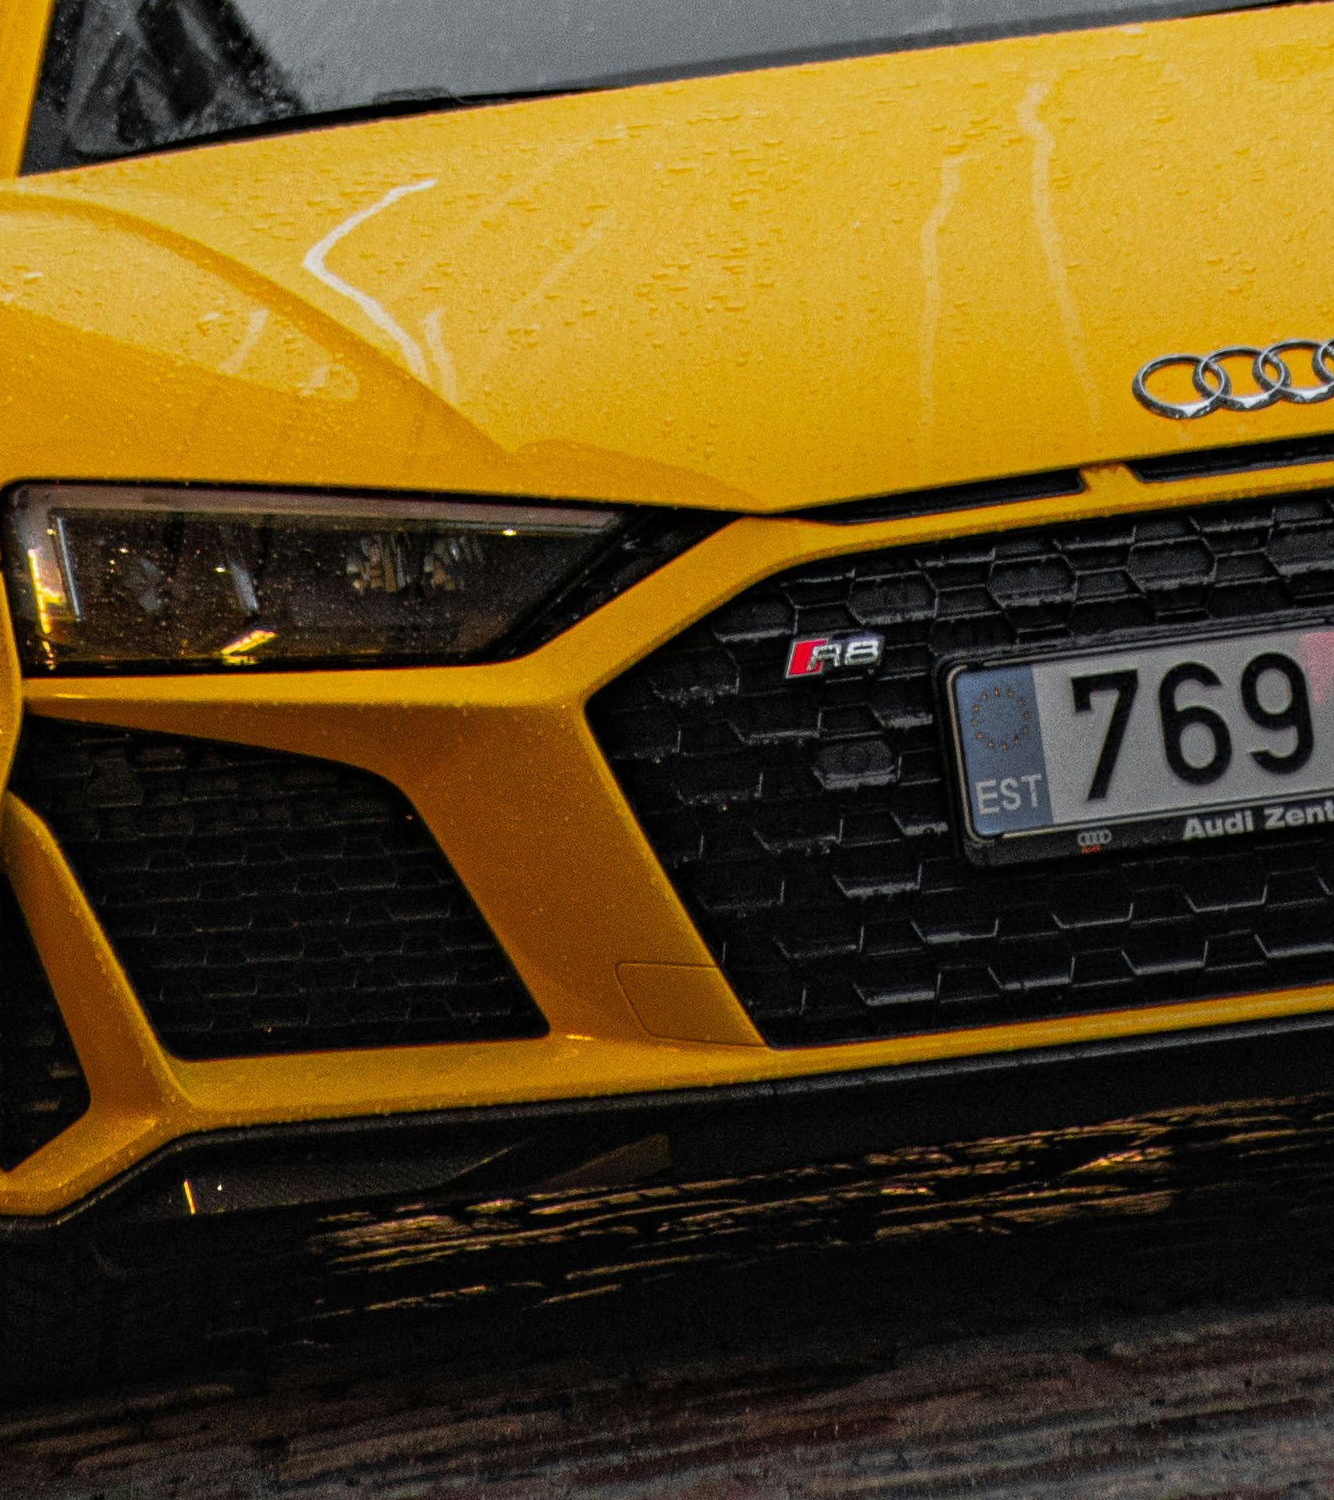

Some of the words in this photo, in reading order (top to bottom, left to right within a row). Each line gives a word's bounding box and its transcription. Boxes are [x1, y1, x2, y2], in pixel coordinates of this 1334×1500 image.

[807, 640, 879, 671] R8
[1071, 652, 1313, 801] 769
[975, 774, 1042, 815] EST
[1182, 810, 1254, 840] Audi
